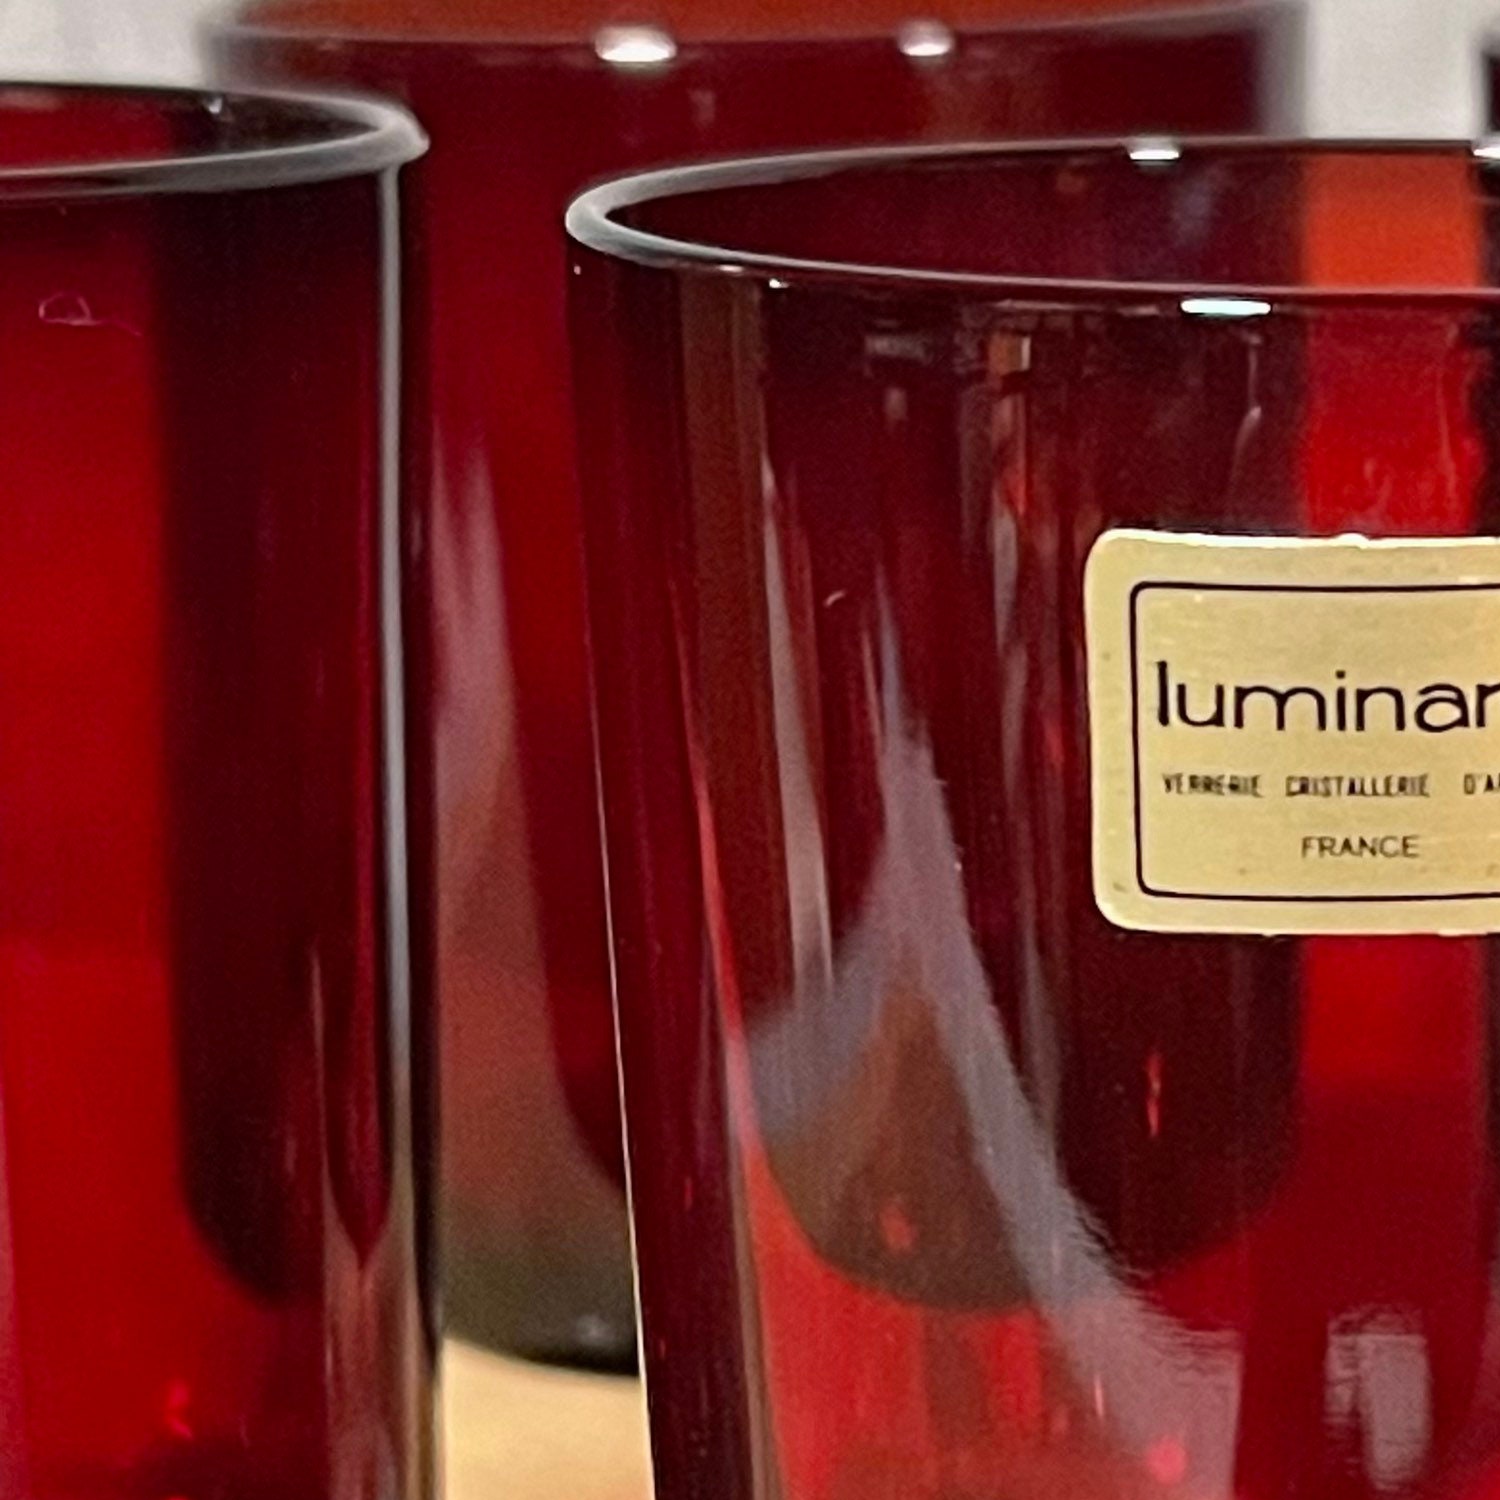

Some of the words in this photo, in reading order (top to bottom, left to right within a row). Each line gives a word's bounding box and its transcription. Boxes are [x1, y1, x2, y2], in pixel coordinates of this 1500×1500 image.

[1162, 772, 1264, 798] VERRERIE
[1285, 774, 1430, 797] CRISTALLERIE
[1302, 834, 1420, 859] FRANCE
